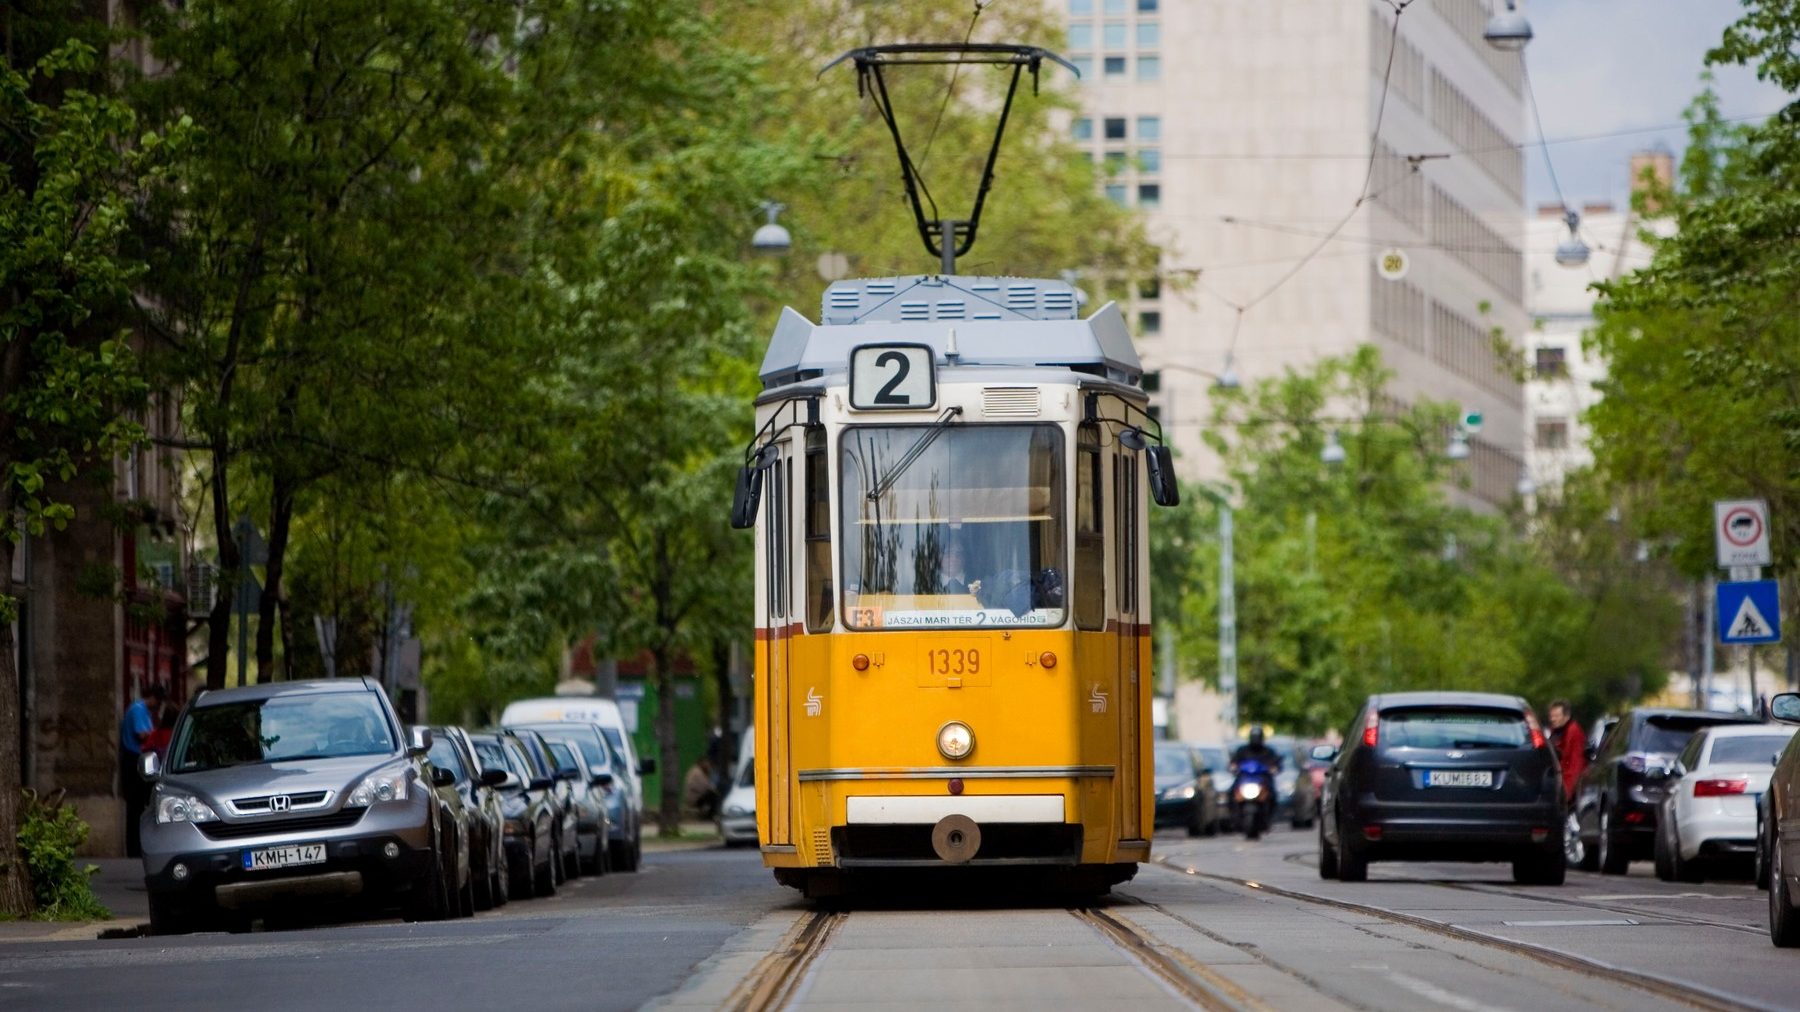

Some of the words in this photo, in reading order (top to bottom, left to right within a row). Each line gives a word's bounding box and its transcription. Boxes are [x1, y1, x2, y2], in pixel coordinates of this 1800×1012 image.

[874, 351, 910, 404] 2
[925, 616, 950, 625] MARI
[976, 611, 987, 625] 2
[928, 649, 980, 675] 1339
[254, 845, 322, 866] KMH-147
